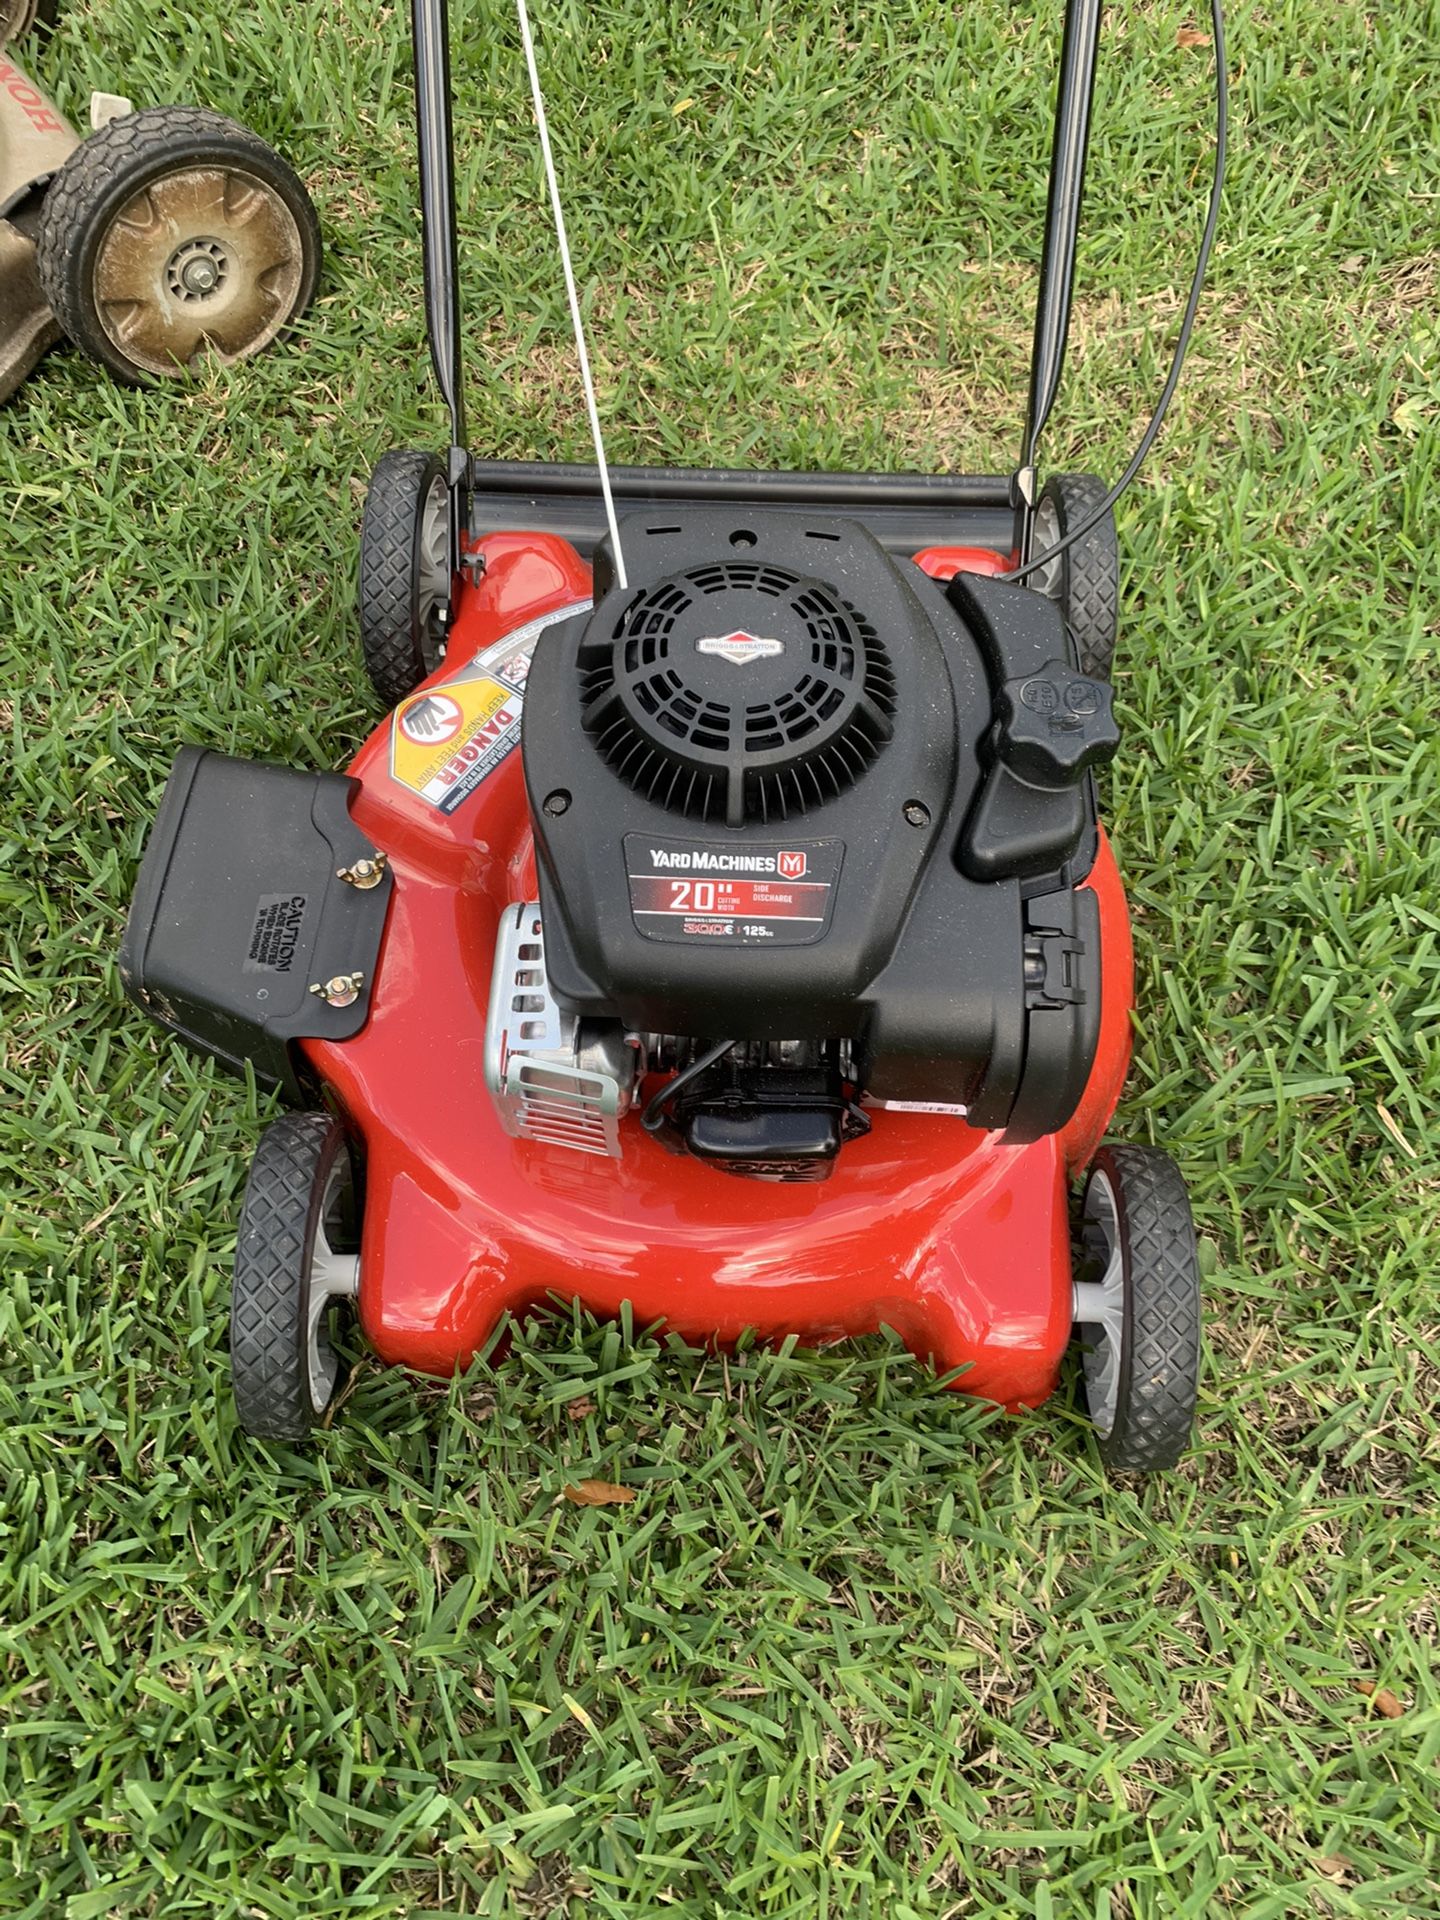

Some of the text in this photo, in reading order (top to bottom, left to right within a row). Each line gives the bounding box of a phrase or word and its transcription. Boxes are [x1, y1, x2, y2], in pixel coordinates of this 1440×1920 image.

[414, 692, 505, 787] KEEP HANDS and FEET AWAY
[436, 709, 513, 785] DANGER
[650, 850, 691, 868] YARD
[692, 852, 776, 872] MACHINES
[753, 884, 769, 893] SIDE
[753, 893, 792, 903] DISCHARGE
[248, 918, 265, 960] RUNNING
[257, 903, 279, 964] WHEN ENGINE
[267, 901, 290, 965] BLADE ROTATES
[275, 896, 306, 972] CAUTION
